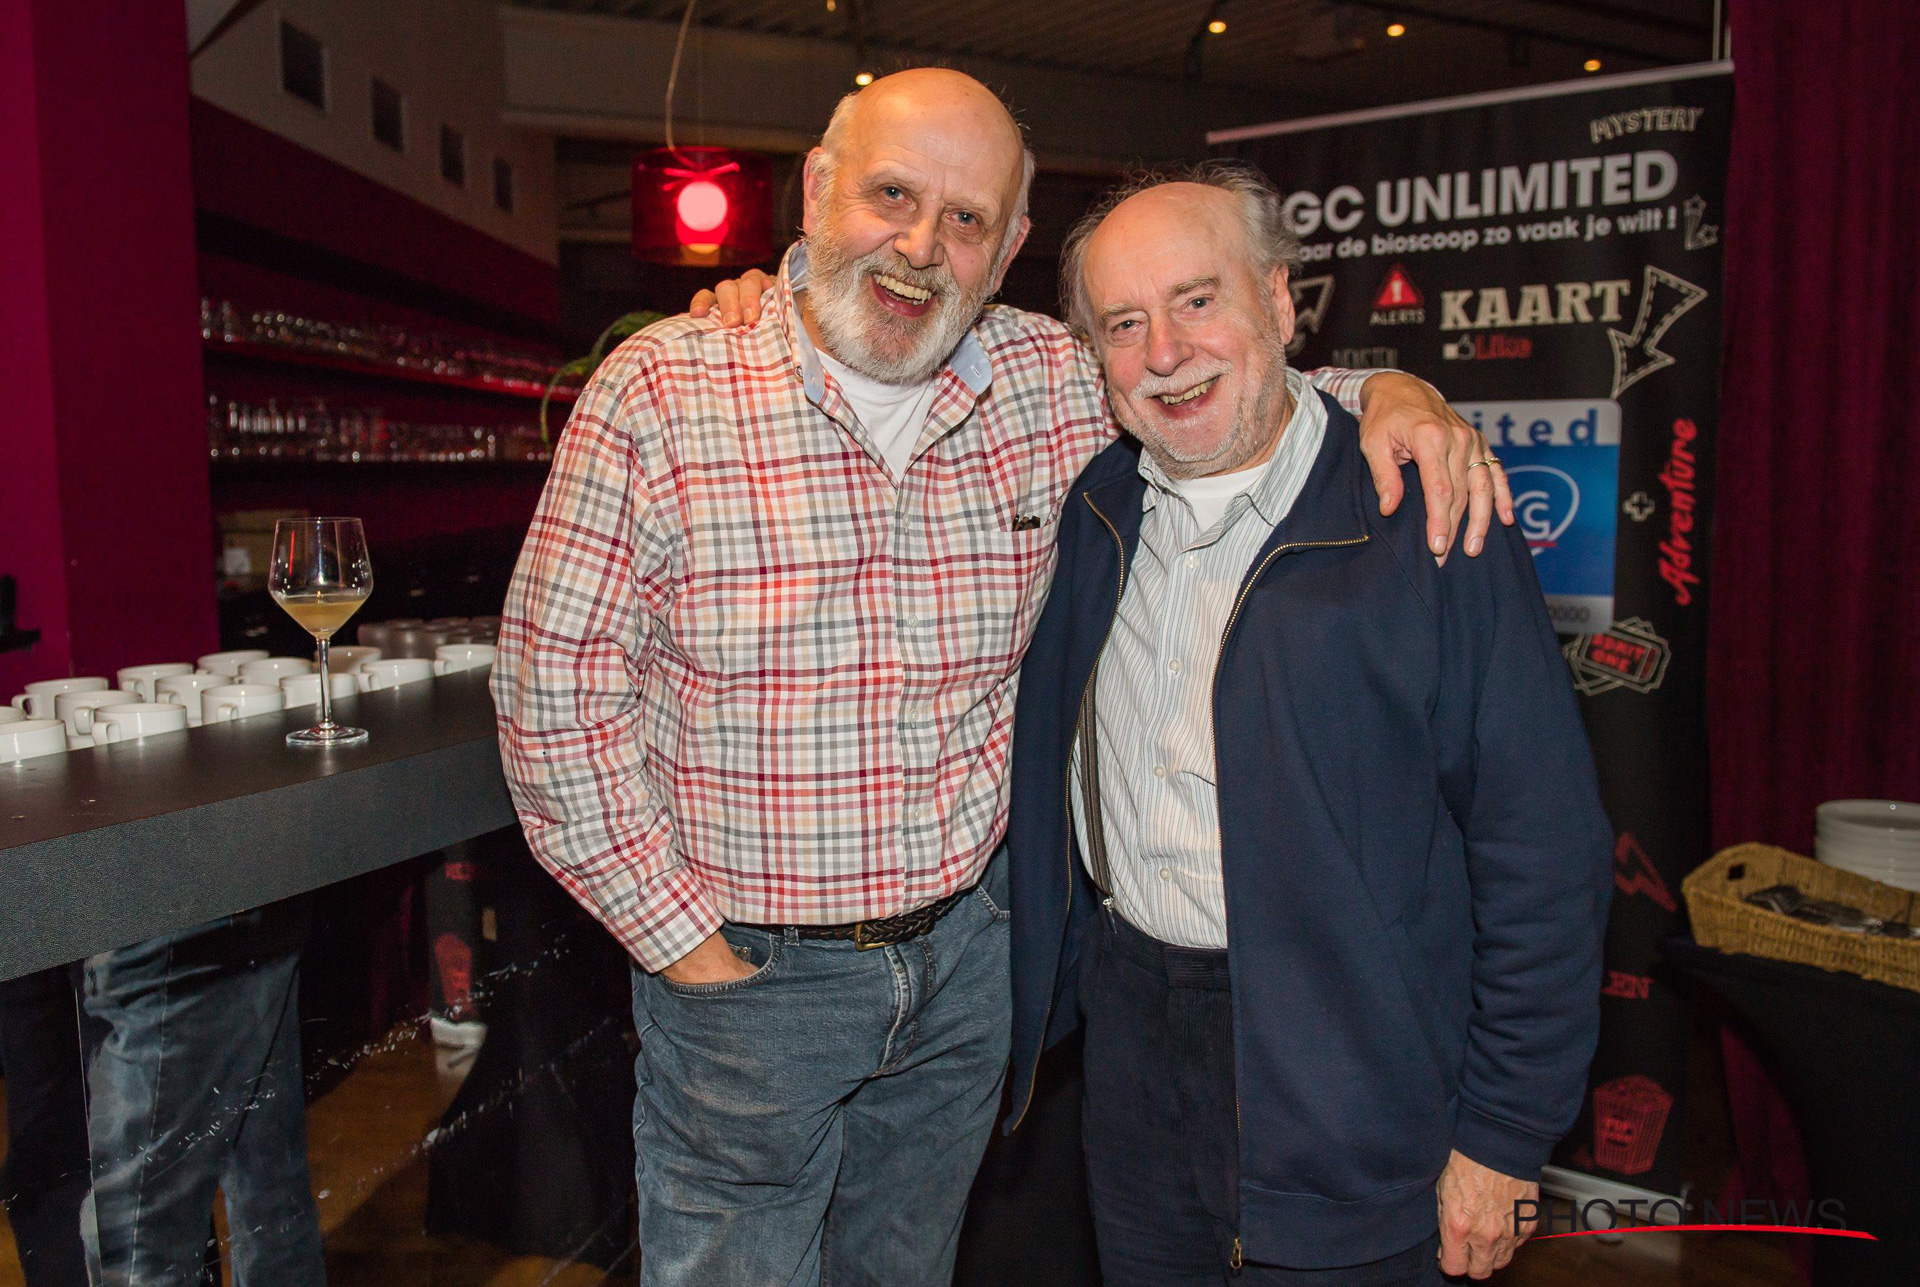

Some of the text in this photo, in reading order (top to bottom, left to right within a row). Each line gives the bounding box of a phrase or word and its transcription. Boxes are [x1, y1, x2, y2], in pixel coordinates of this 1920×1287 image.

[1590, 106, 1704, 144] MYSTERY
[1282, 150, 1679, 238] GC UNLIMITED
[1299, 242, 1334, 262] aar
[1336, 236, 1367, 259] de
[1371, 228, 1479, 256] bioscoop
[1483, 225, 1512, 246] zo
[1516, 214, 1580, 243] vaak
[1584, 213, 1612, 243] je
[1440, 279, 1630, 331] KAART
[1475, 333, 1532, 361] Like
[1472, 407, 1598, 448] ited
[1658, 417, 1701, 607] Adventure
